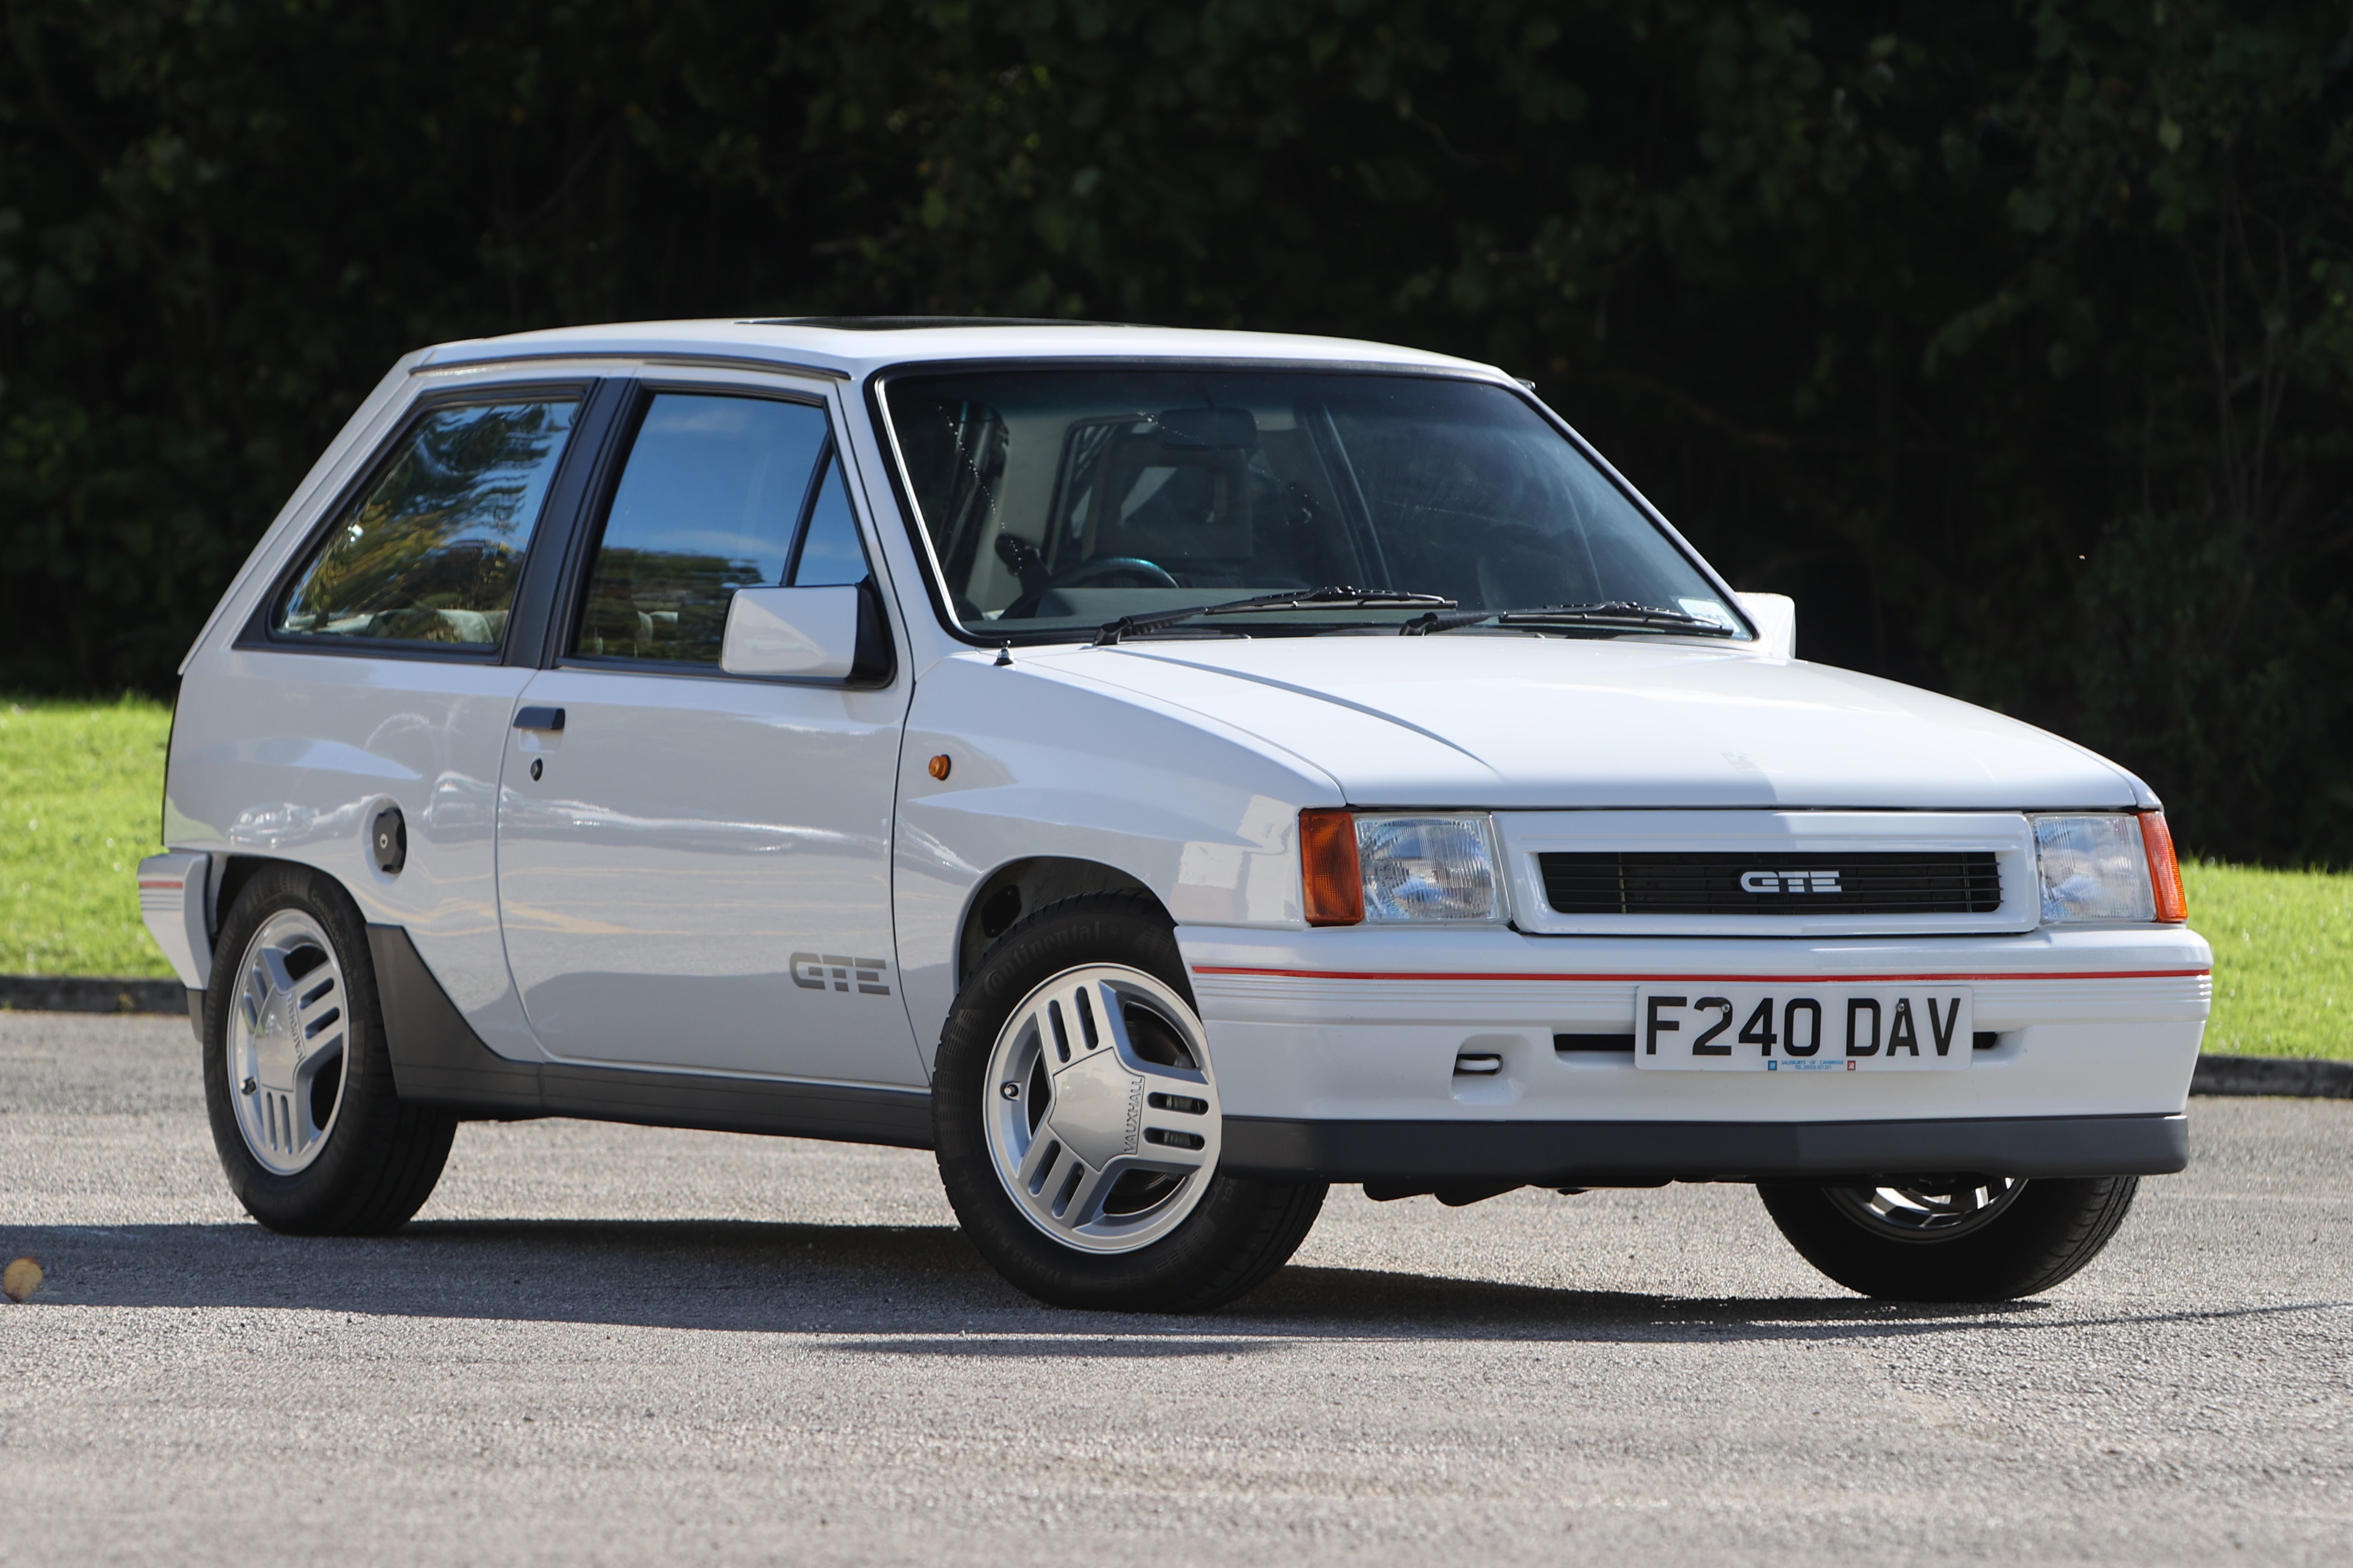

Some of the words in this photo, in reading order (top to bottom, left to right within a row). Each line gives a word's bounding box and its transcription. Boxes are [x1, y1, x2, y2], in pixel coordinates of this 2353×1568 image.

[1741, 870, 1842, 893] GTE
[789, 952, 891, 996] GTE
[984, 920, 1102, 998] Continental
[1647, 996, 1822, 1056] F240
[1846, 997, 1961, 1056] DAV
[1124, 1077, 1142, 1153] VAUXHALL
